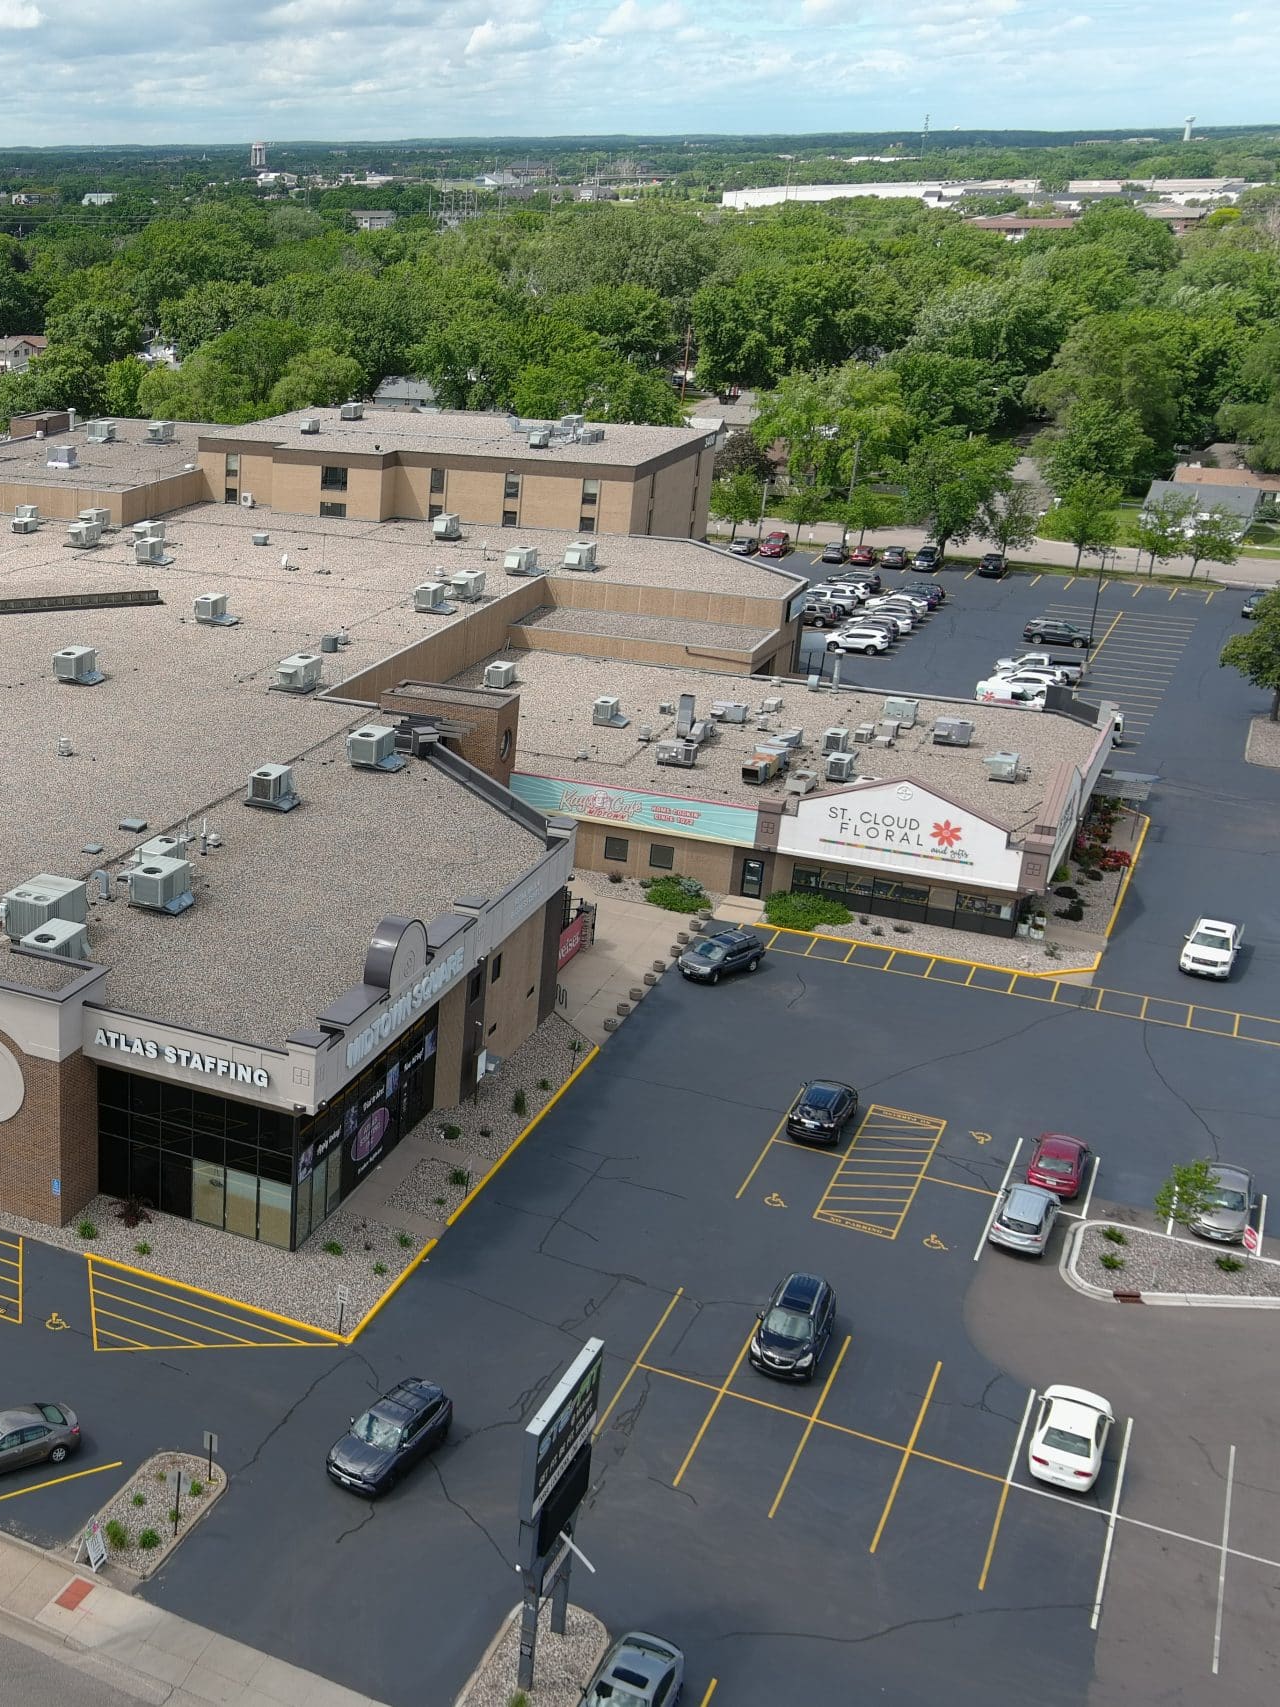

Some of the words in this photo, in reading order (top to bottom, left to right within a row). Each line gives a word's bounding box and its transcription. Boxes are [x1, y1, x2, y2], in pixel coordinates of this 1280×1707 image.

[586, 807, 630, 821] MIDTOWN
[828, 806, 852, 821] ST.
[860, 811, 920, 831] CLOUD
[839, 822, 923, 847] FLORAL
[930, 846, 949, 855] and
[949, 848, 969, 860] gifts
[346, 991, 413, 1070] MIDTOWN
[412, 946, 465, 1009] SQUARE
[94, 1029, 159, 1060] ATLAS
[164, 1046, 269, 1089] STAFFING
[844, 1221, 884, 1234] PARKING
